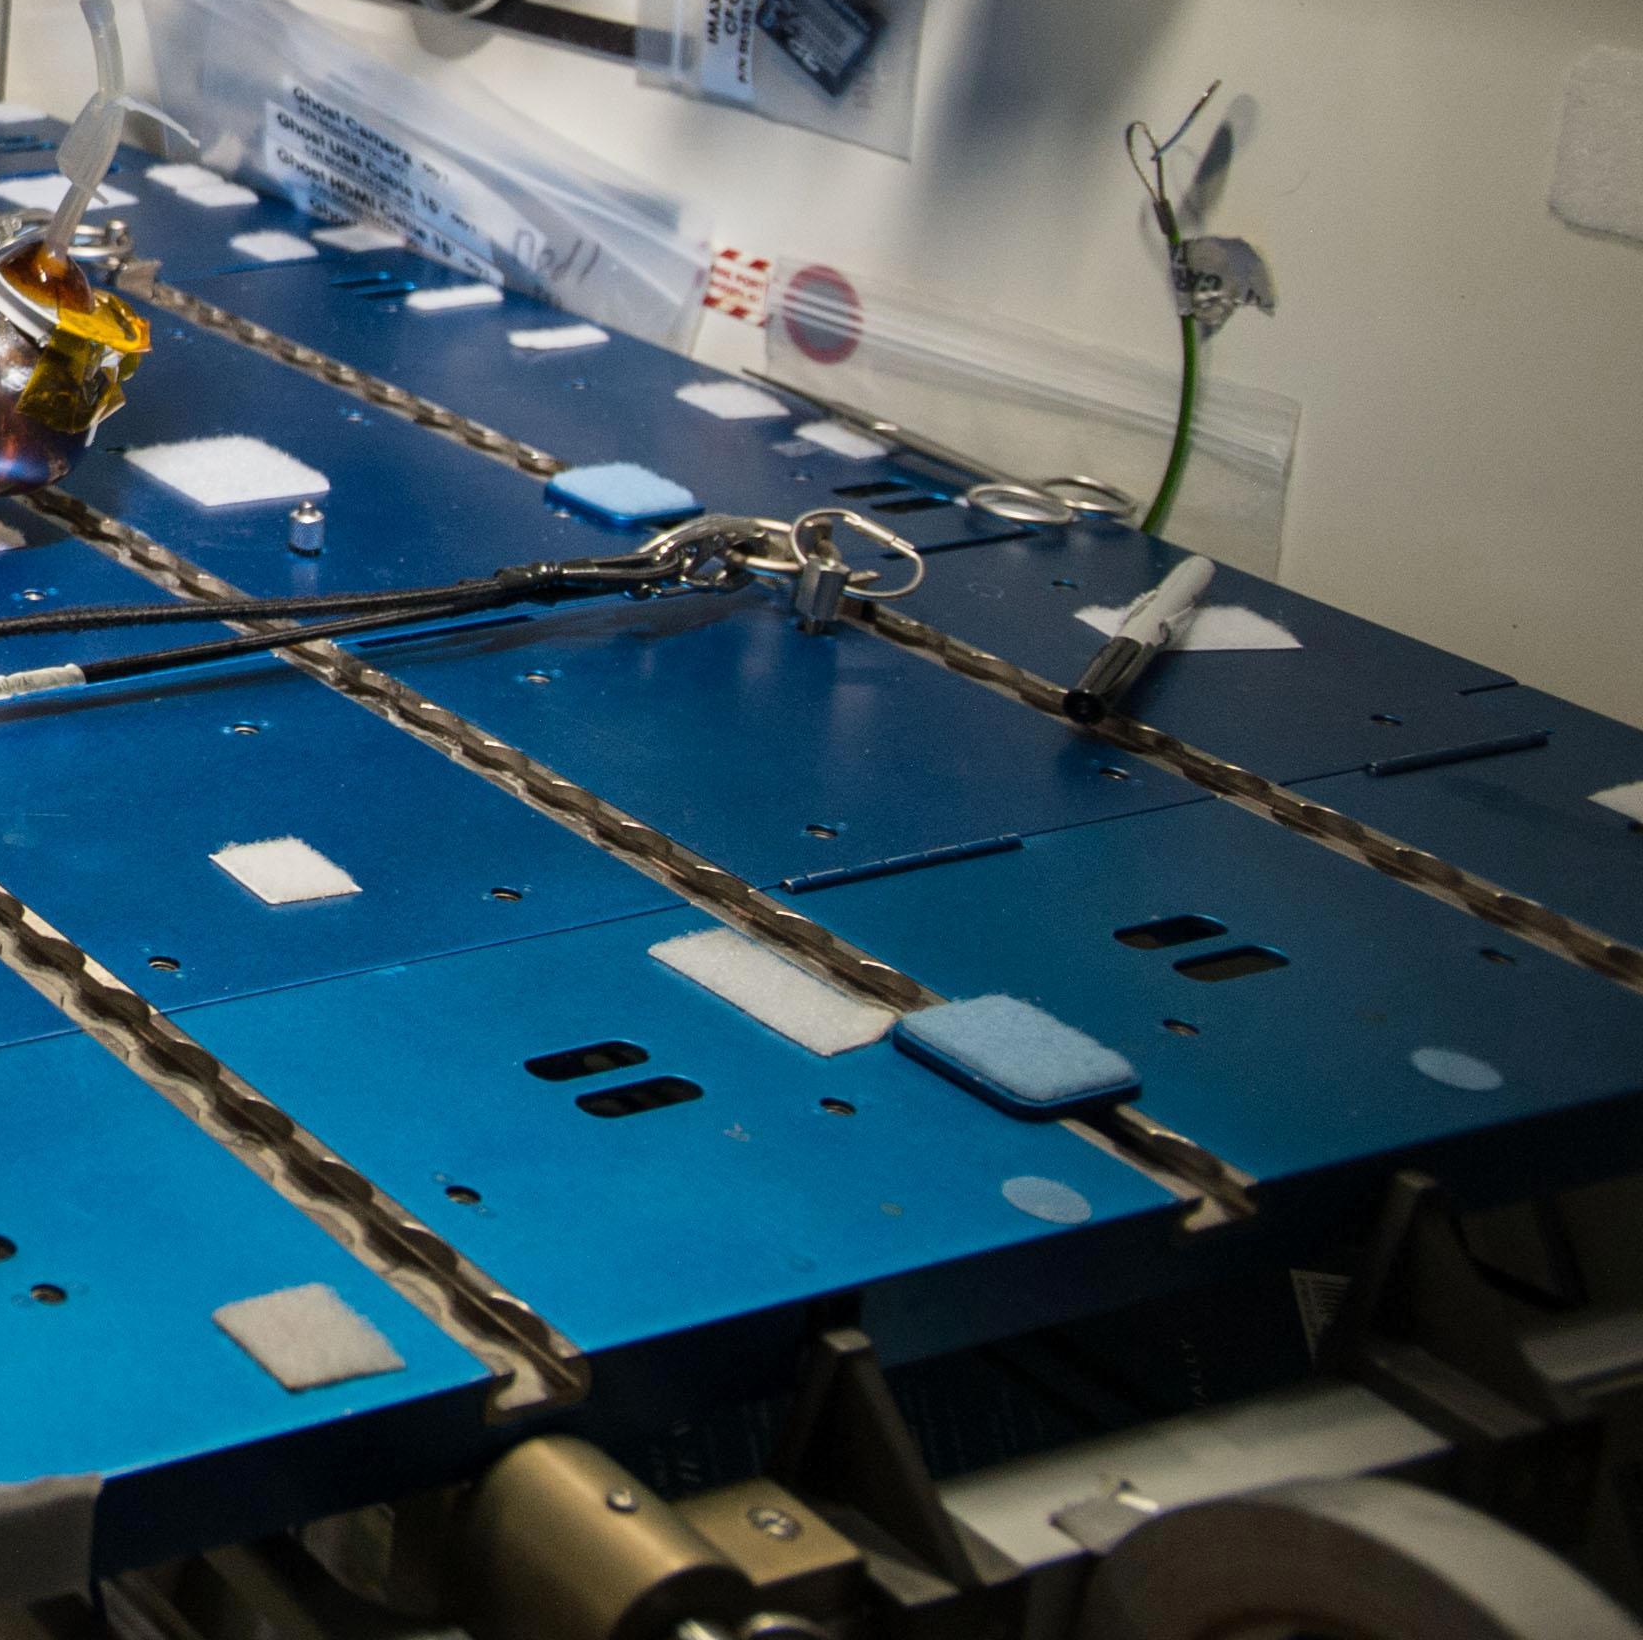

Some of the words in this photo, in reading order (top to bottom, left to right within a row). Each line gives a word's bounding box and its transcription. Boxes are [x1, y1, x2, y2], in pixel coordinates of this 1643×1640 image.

[724, 7, 739, 36] CF
[277, 112, 327, 147] Ghost
[293, 86, 341, 122] Ghost
[344, 116, 413, 164] Camera
[277, 147, 327, 184] Ghost
